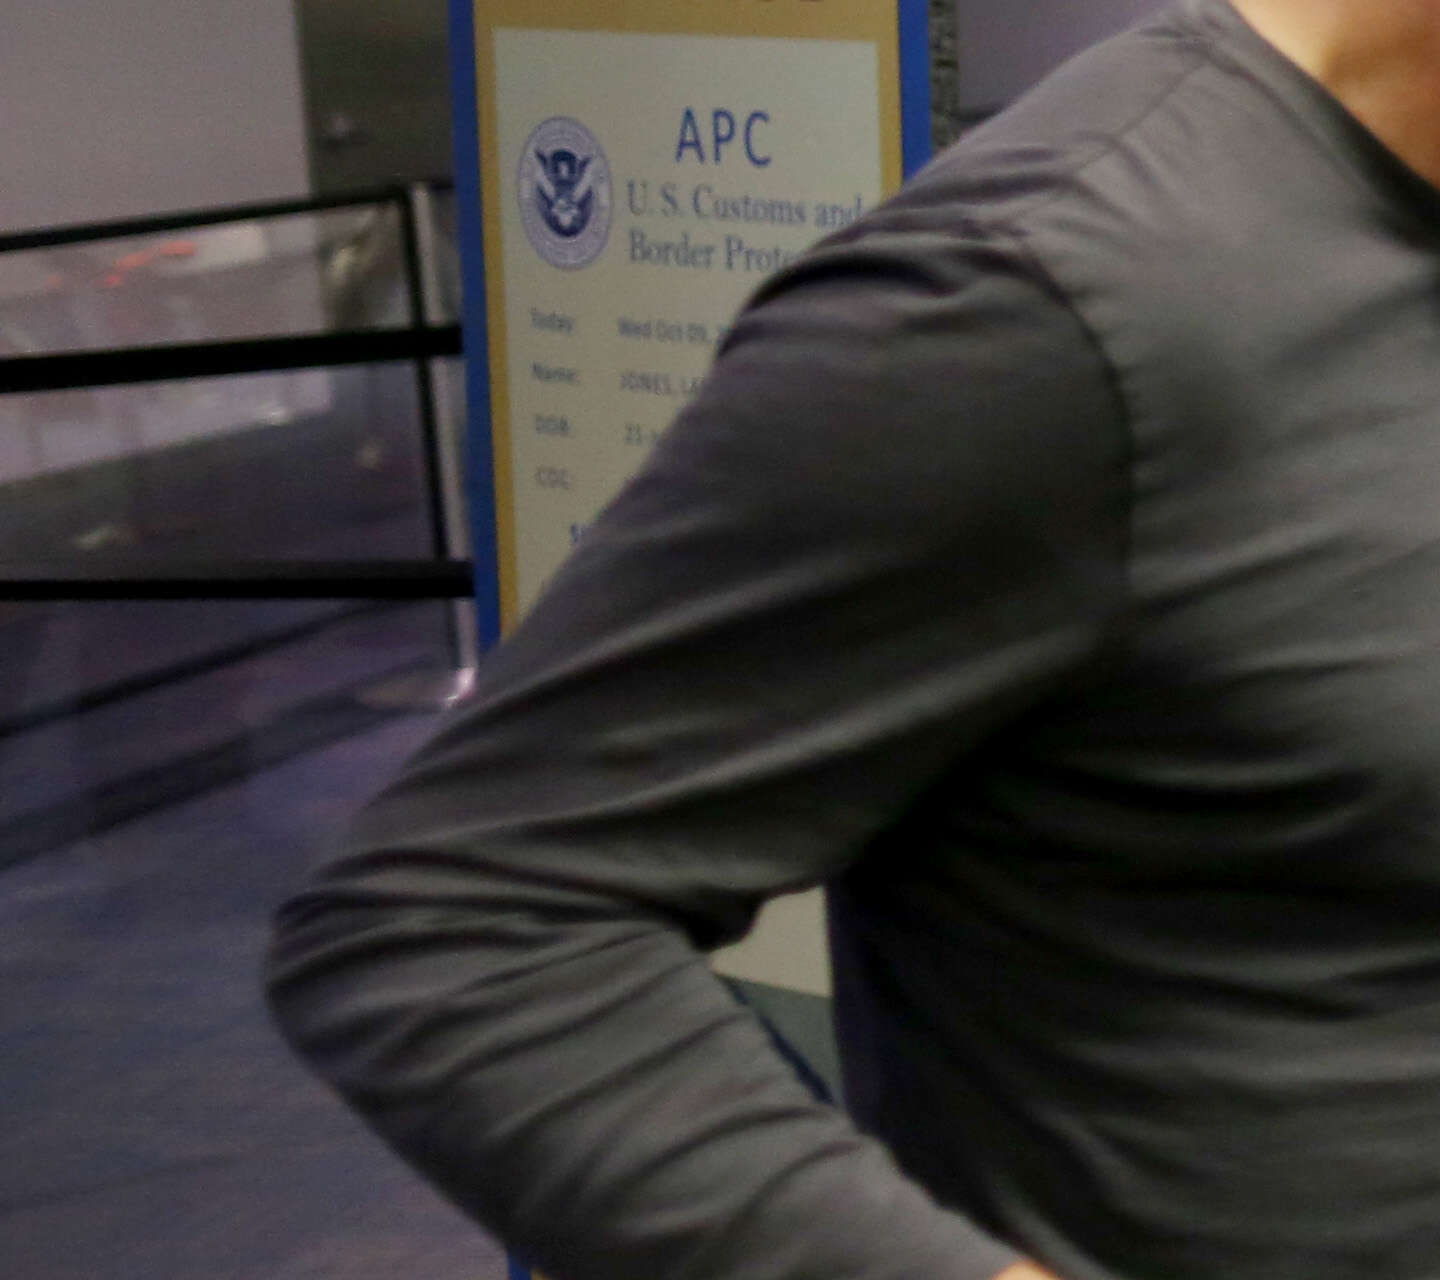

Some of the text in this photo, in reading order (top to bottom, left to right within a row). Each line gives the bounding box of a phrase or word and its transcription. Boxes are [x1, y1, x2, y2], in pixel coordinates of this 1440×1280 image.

[676, 106, 772, 167] APC
[692, 183, 806, 226] Customs
[814, 194, 862, 228] and
[629, 228, 715, 270] Border
